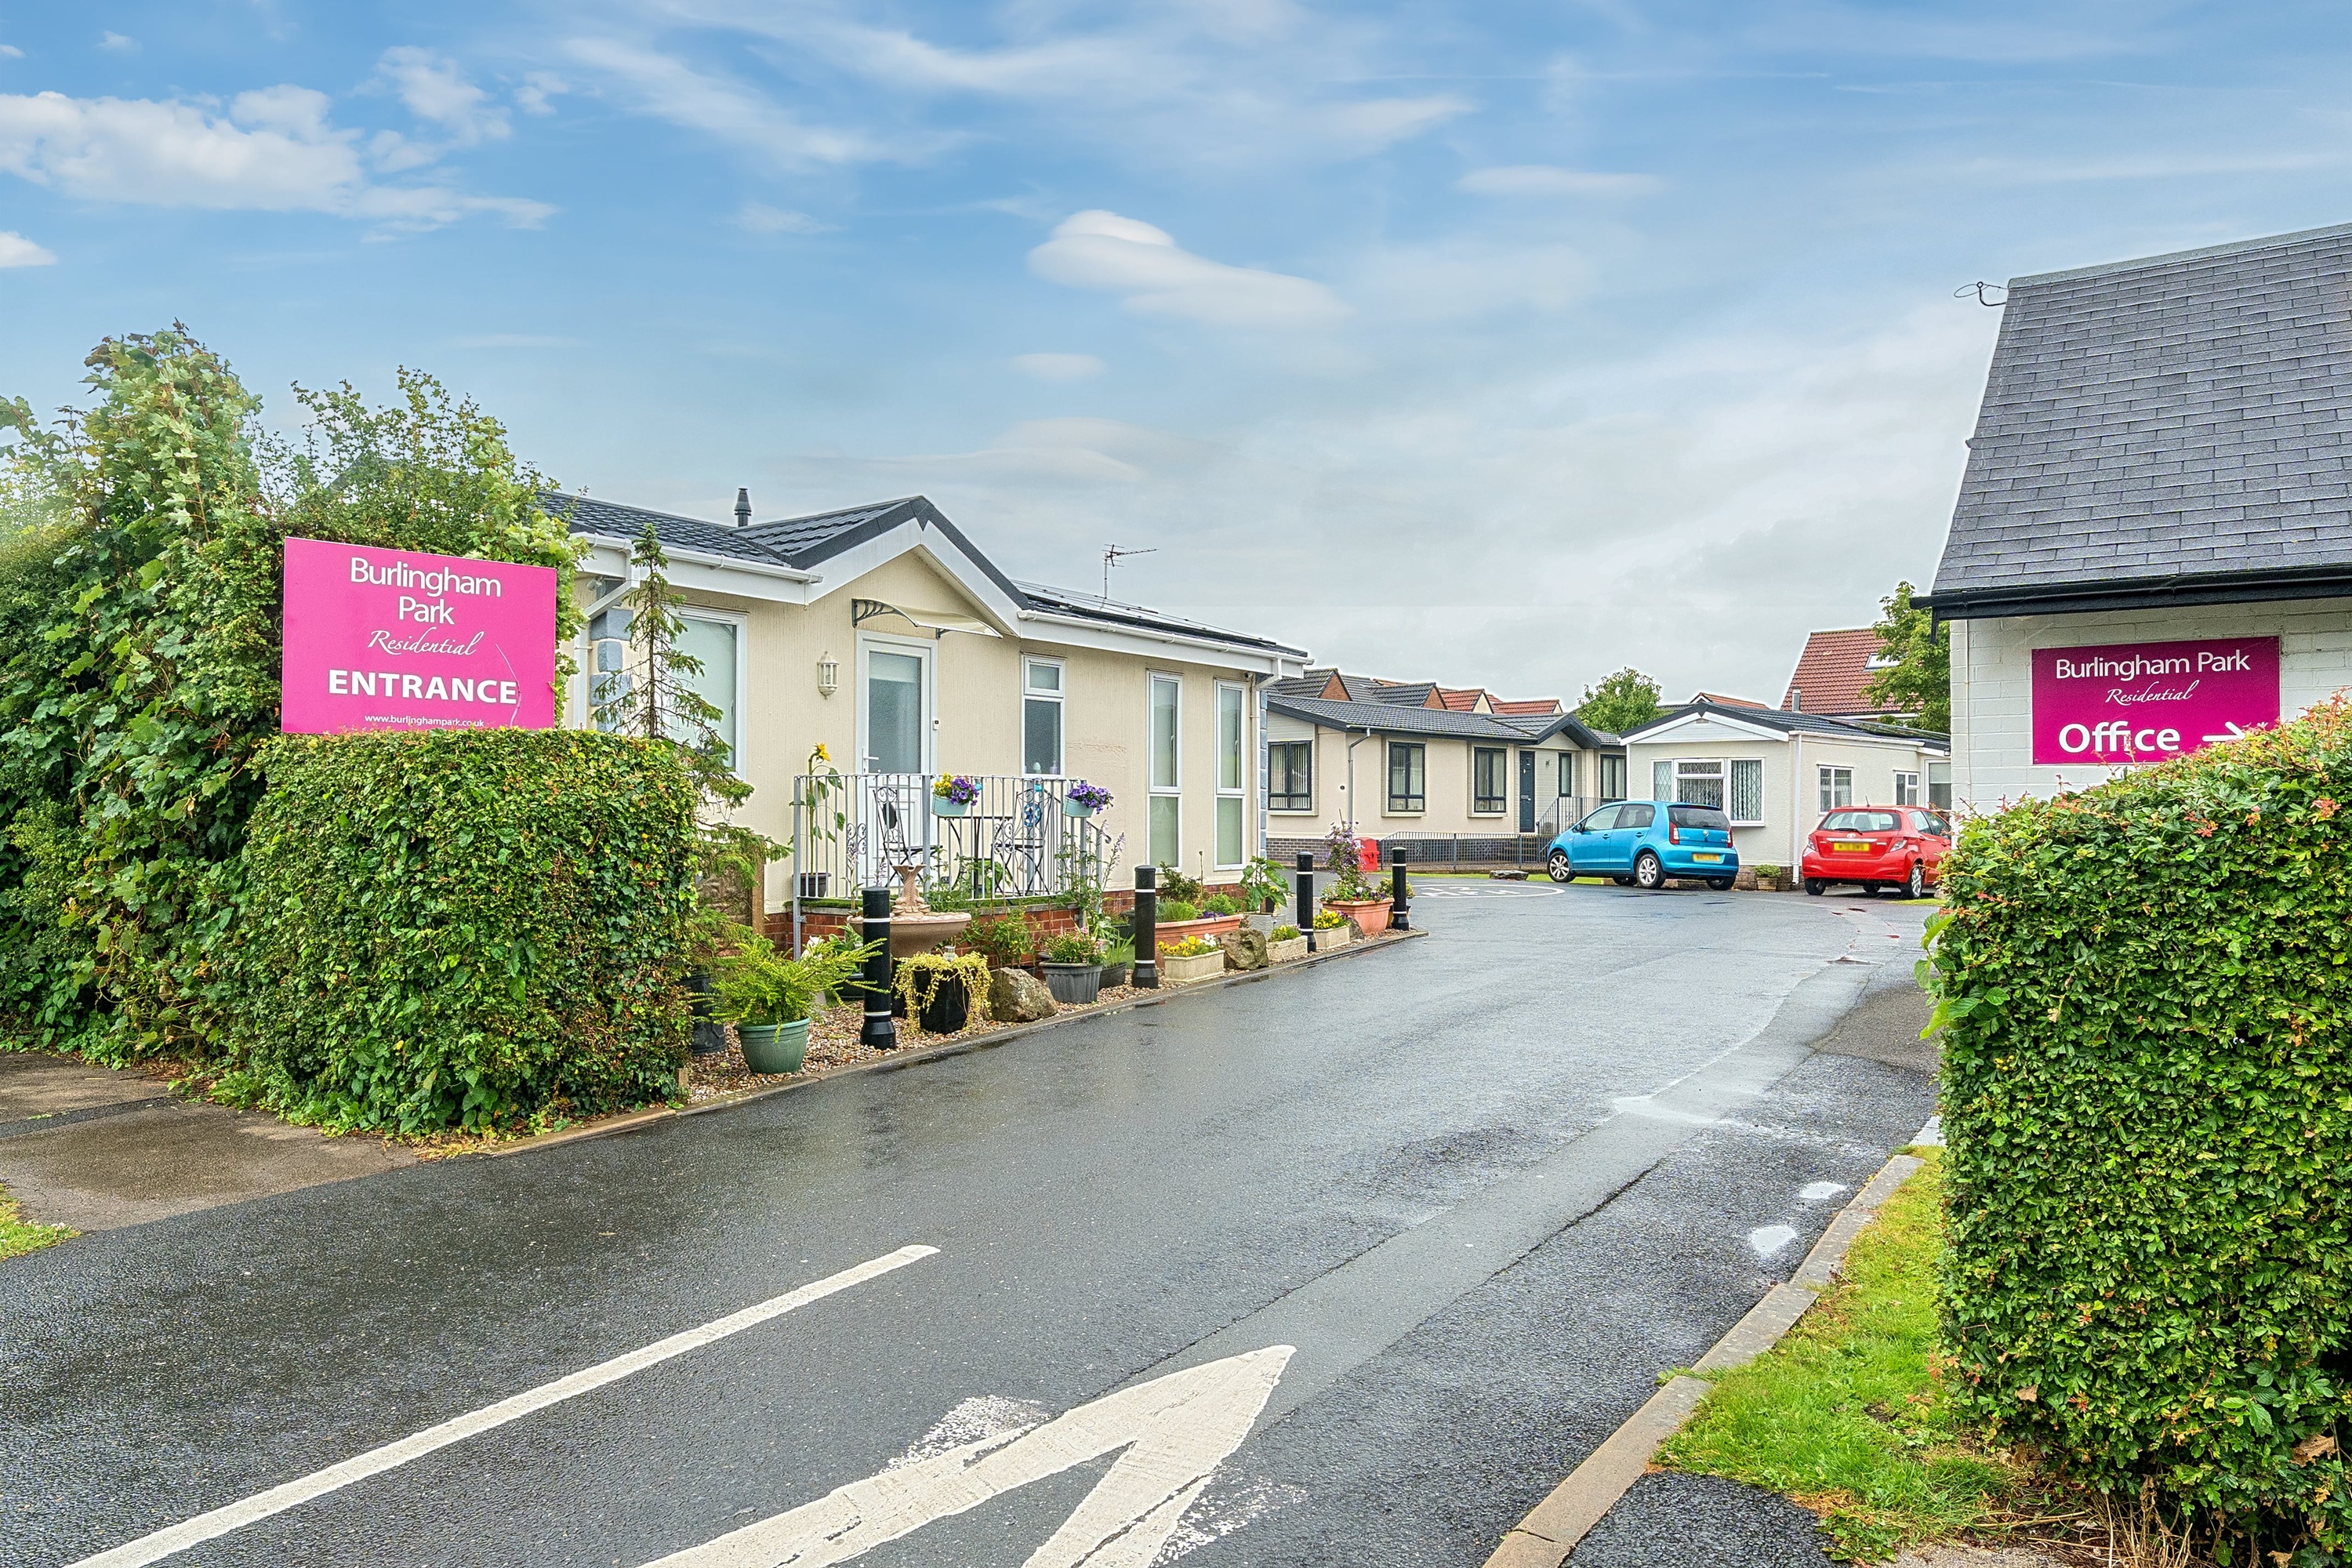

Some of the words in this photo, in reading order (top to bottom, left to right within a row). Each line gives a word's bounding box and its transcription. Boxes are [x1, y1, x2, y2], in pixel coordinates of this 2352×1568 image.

[350, 557, 502, 597] Burlingham
[398, 595, 456, 625] Park
[367, 626, 485, 655] Residential
[2056, 654, 2190, 681] Burlingham
[2198, 649, 2251, 673] Park
[328, 669, 517, 704] ENTRANCE
[2105, 679, 2200, 706] Residential
[2058, 720, 2181, 753] Office
